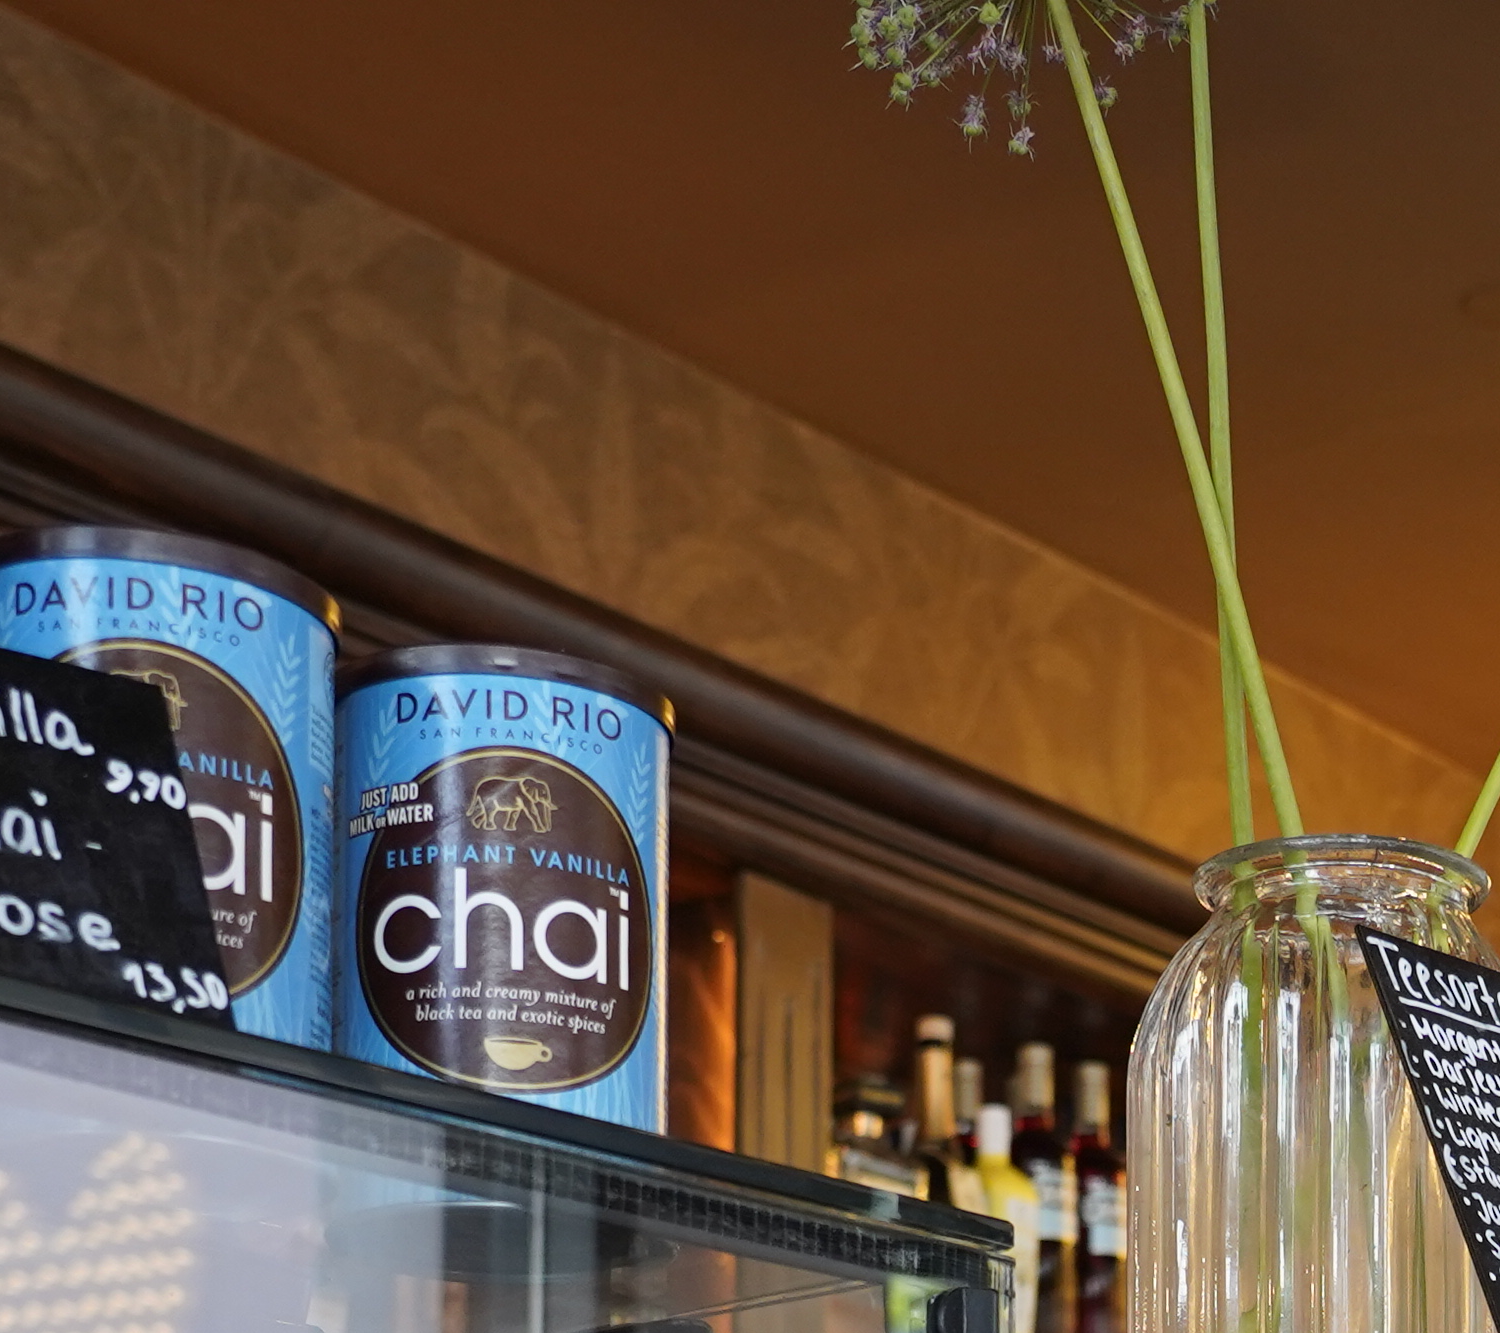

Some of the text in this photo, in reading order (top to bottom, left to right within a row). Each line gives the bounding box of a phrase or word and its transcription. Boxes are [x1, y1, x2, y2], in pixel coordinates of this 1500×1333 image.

[14, 575, 265, 631] DAVID RIO
[97, 619, 242, 648] FRANCISCO
[396, 688, 623, 741] DAVID RIO
[419, 727, 604, 756] SAN FRANCISCO
[105, 759, 188, 810] 9,90
[178, 750, 275, 791] ANILLA
[361, 781, 419, 812] JUST ADD
[350, 815, 375, 839] MILK
[386, 803, 434, 827] WATER
[187, 791, 274, 903] ai
[386, 845, 631, 888] ELEPHANT VANILLA
[216, 932, 244, 950] ices
[237, 910, 258, 934] of
[374, 867, 630, 992] chai
[121, 960, 231, 1015] 13,50
[405, 981, 618, 1021] a rich and creamy mixture of
[415, 1004, 607, 1036] black tea and exotic spices
